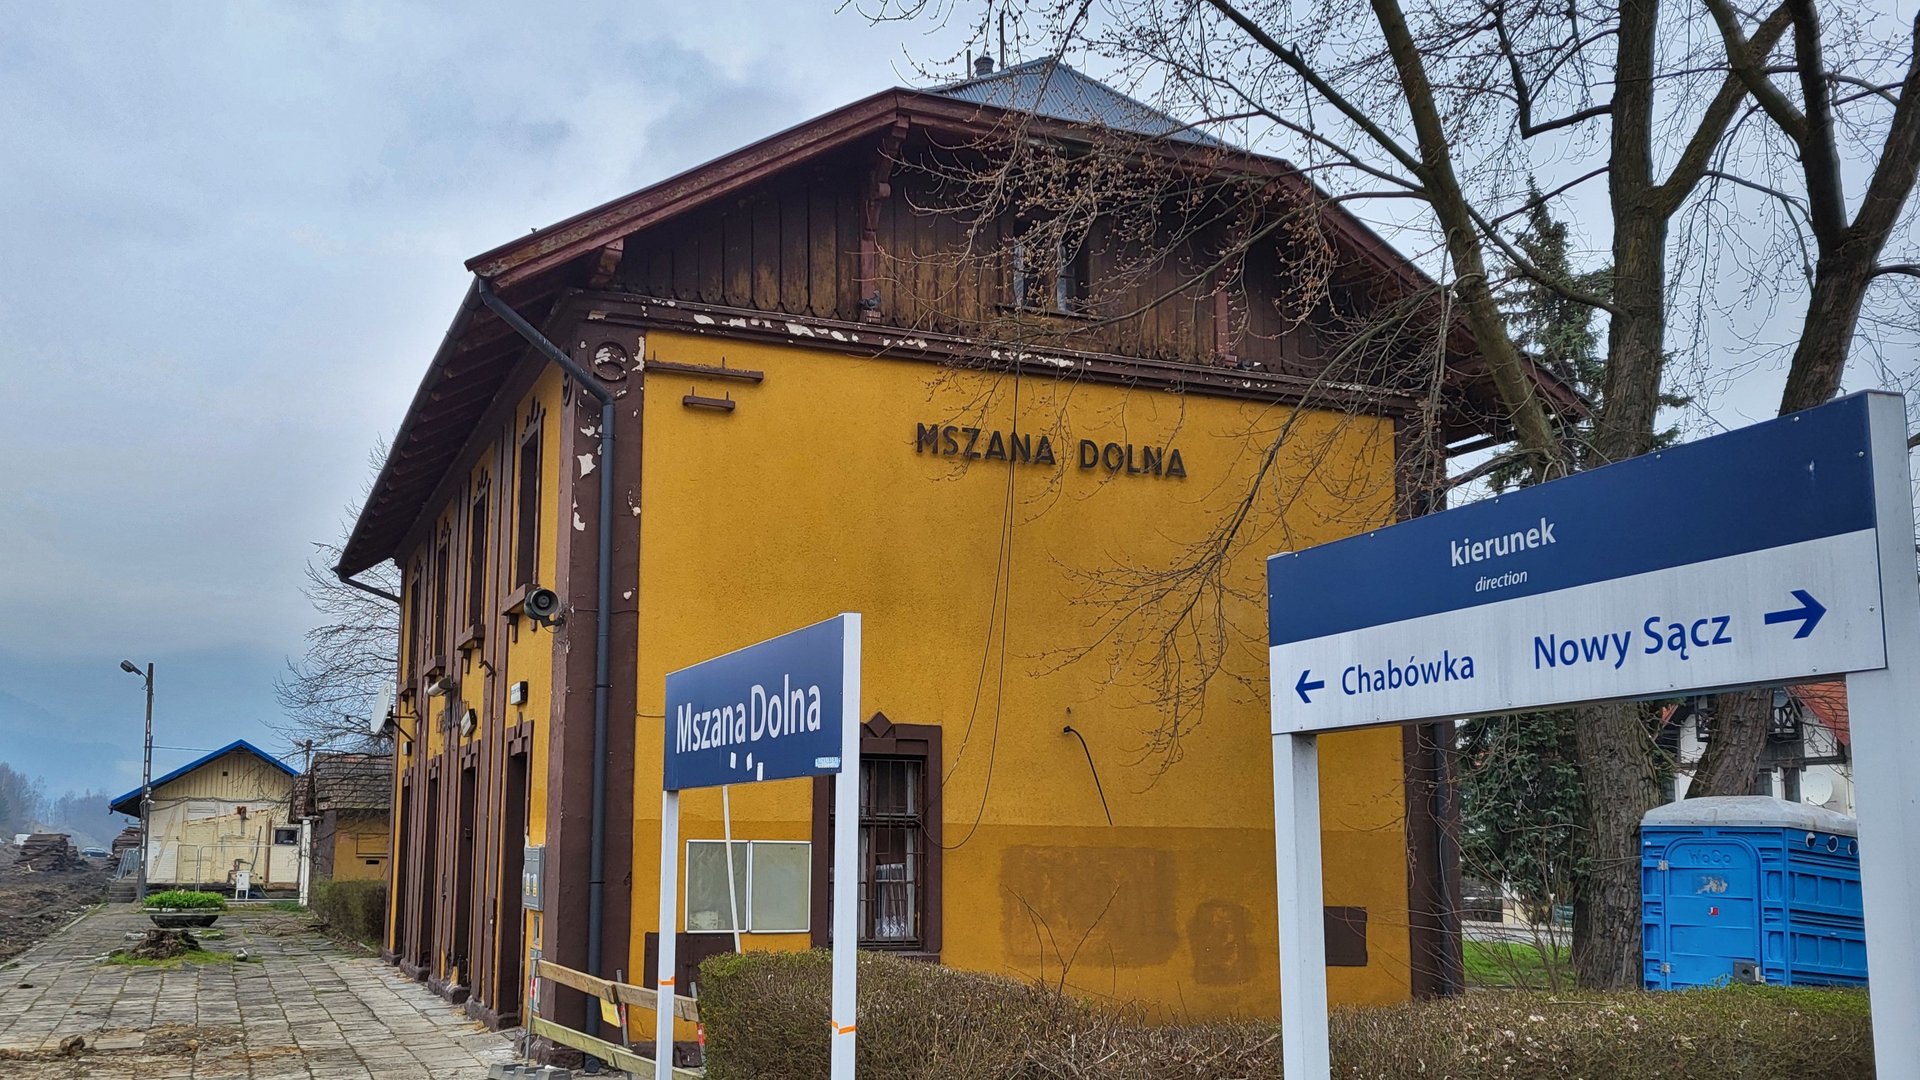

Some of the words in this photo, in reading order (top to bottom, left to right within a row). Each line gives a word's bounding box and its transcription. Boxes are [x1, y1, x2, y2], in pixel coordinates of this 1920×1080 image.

[916, 422, 1056, 466] MSZANA
[1079, 438, 1187, 478] DOLNA
[1450, 517, 1557, 567] kierunek
[1474, 568, 1528, 593] direction
[1533, 629, 1632, 670] Nowy
[1643, 614, 1733, 662] Sącz
[1341, 650, 1475, 696] Chabówka
[676, 702, 746, 754] Mszana
[750, 674, 821, 742] Dolna
